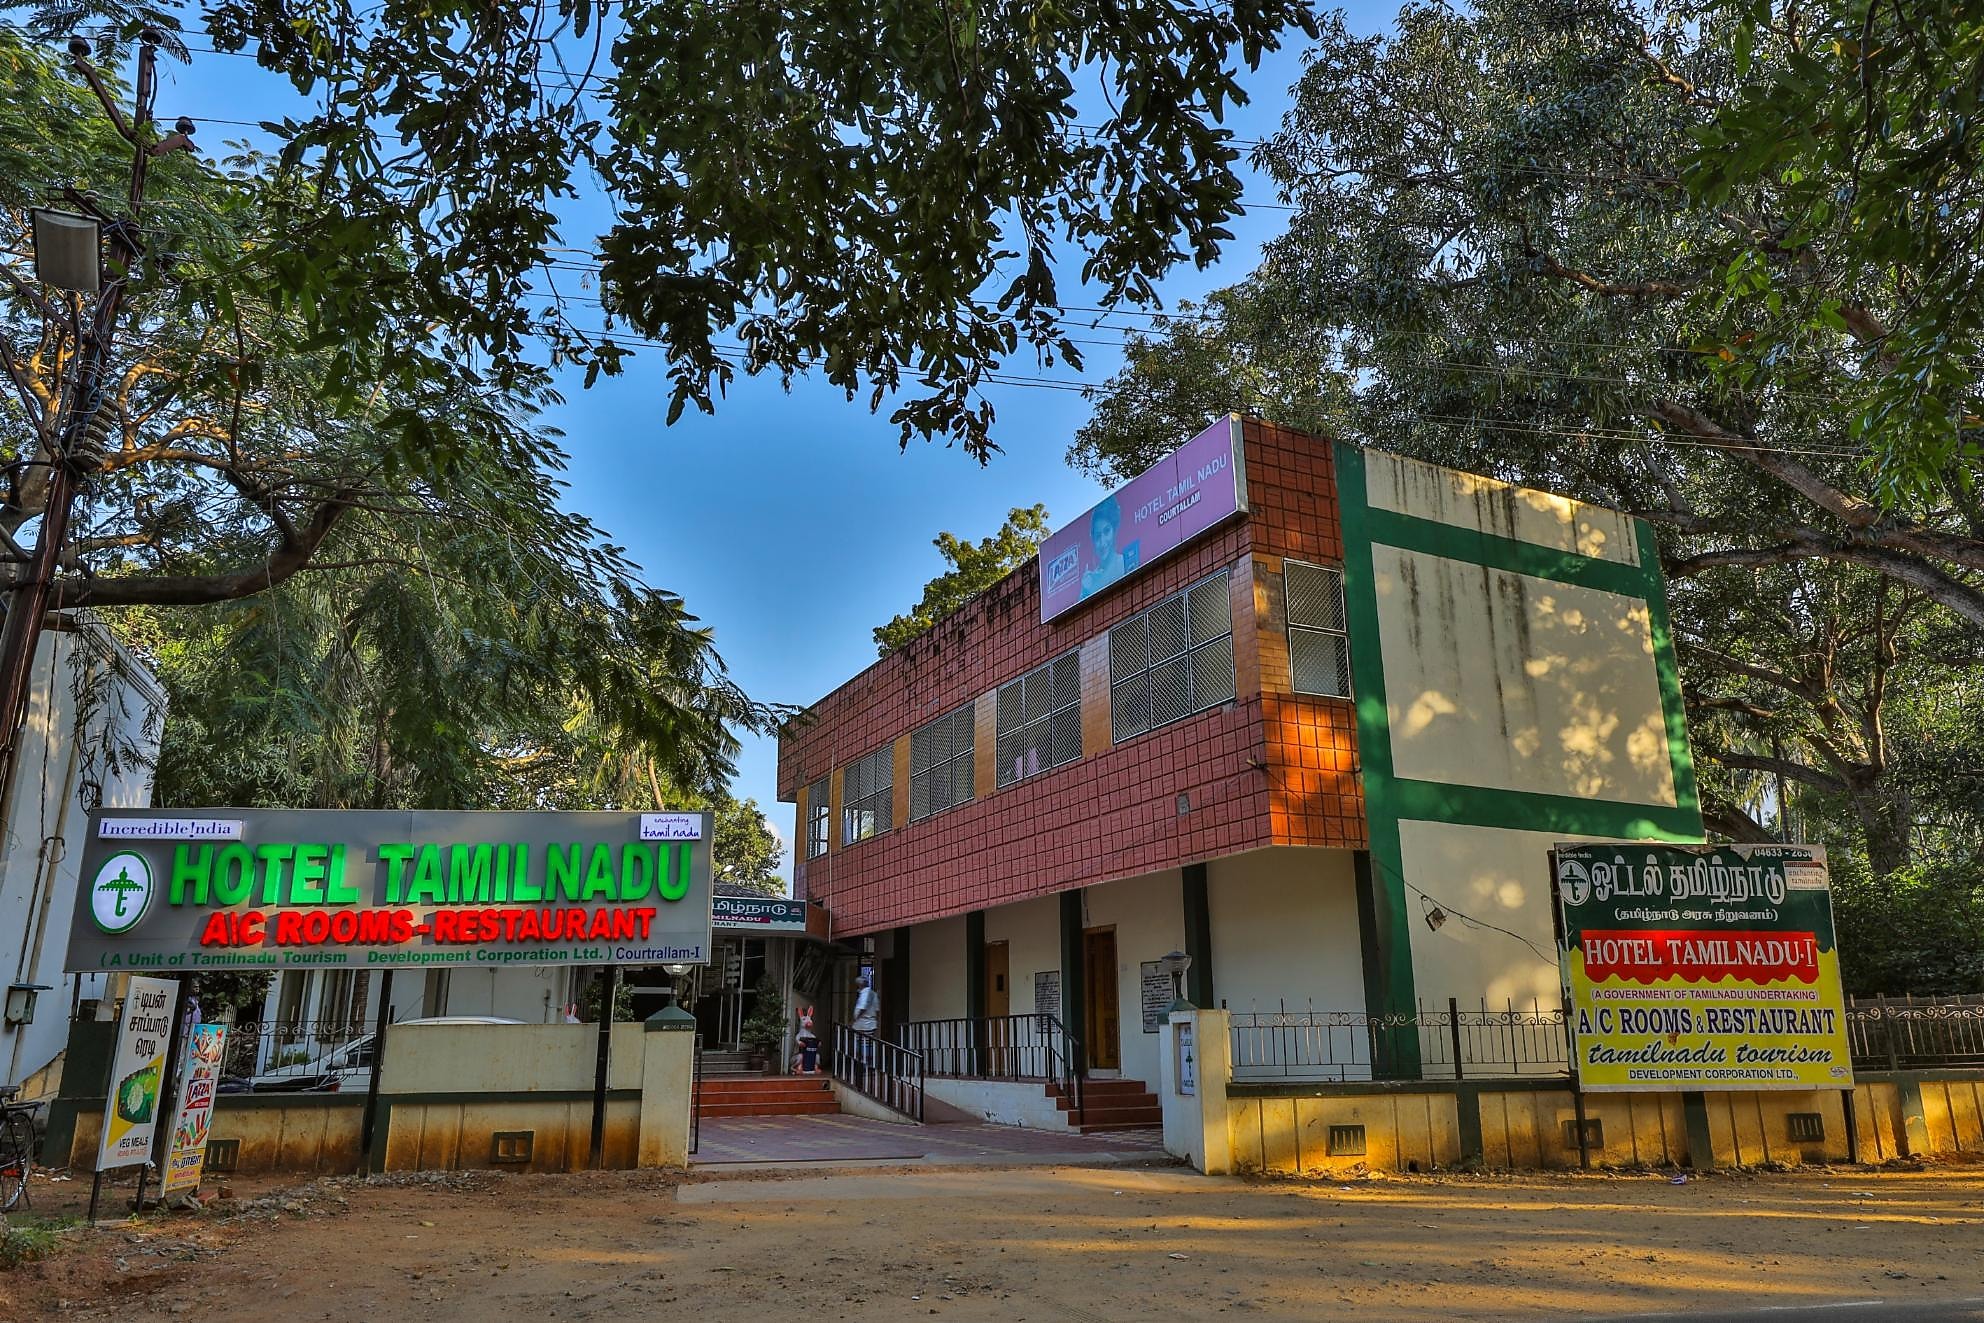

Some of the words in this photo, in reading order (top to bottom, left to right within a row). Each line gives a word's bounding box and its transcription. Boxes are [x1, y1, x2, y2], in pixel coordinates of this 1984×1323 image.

[1134, 495, 1165, 524] HOTEL
[1167, 475, 1196, 502] TAMIL
[1197, 453, 1227, 482] NADU
[1160, 490, 1201, 525] COURTALLAM
[643, 824, 670, 837] tamil
[673, 826, 699, 837] nadu
[168, 843, 361, 905] HOTEL
[378, 842, 692, 903] TAMILNADU
[1669, 854, 1785, 906] தமிழ்நாடு
[1682, 909, 1713, 920] அரசு
[128, 952, 163, 966] Unit
[168, 952, 186, 965] of
[192, 951, 277, 966] Tamilnadu
[283, 950, 347, 964] Tourism
[368, 949, 472, 964] Development
[476, 948, 568, 963] Corporation
[1584, 939, 1663, 965] HOTEL
[140, 990, 167, 1012] டிபன்
[1603, 989, 1672, 1000] GOVERNMENT
[1674, 990, 1687, 1000] OF
[1690, 990, 1744, 1000] TAMILNADU
[1746, 990, 1819, 1001] UNDERTAKING)
[129, 1012, 169, 1038] சாப்பாடு
[1579, 1007, 1613, 1034] A/C
[1619, 1008, 1693, 1034] ROOMS
[1696, 1015, 1704, 1034] &
[1705, 1008, 1835, 1034] RESTAURANT
[1588, 1040, 1727, 1064] tamilnadu
[1736, 1043, 1832, 1063] tourism
[1629, 1069, 1702, 1080] DEVELOPMENT
[1705, 1069, 1773, 1079] CORPORATION
[119, 1138, 130, 1148] VEG
[131, 1136, 149, 1147] MEALS
